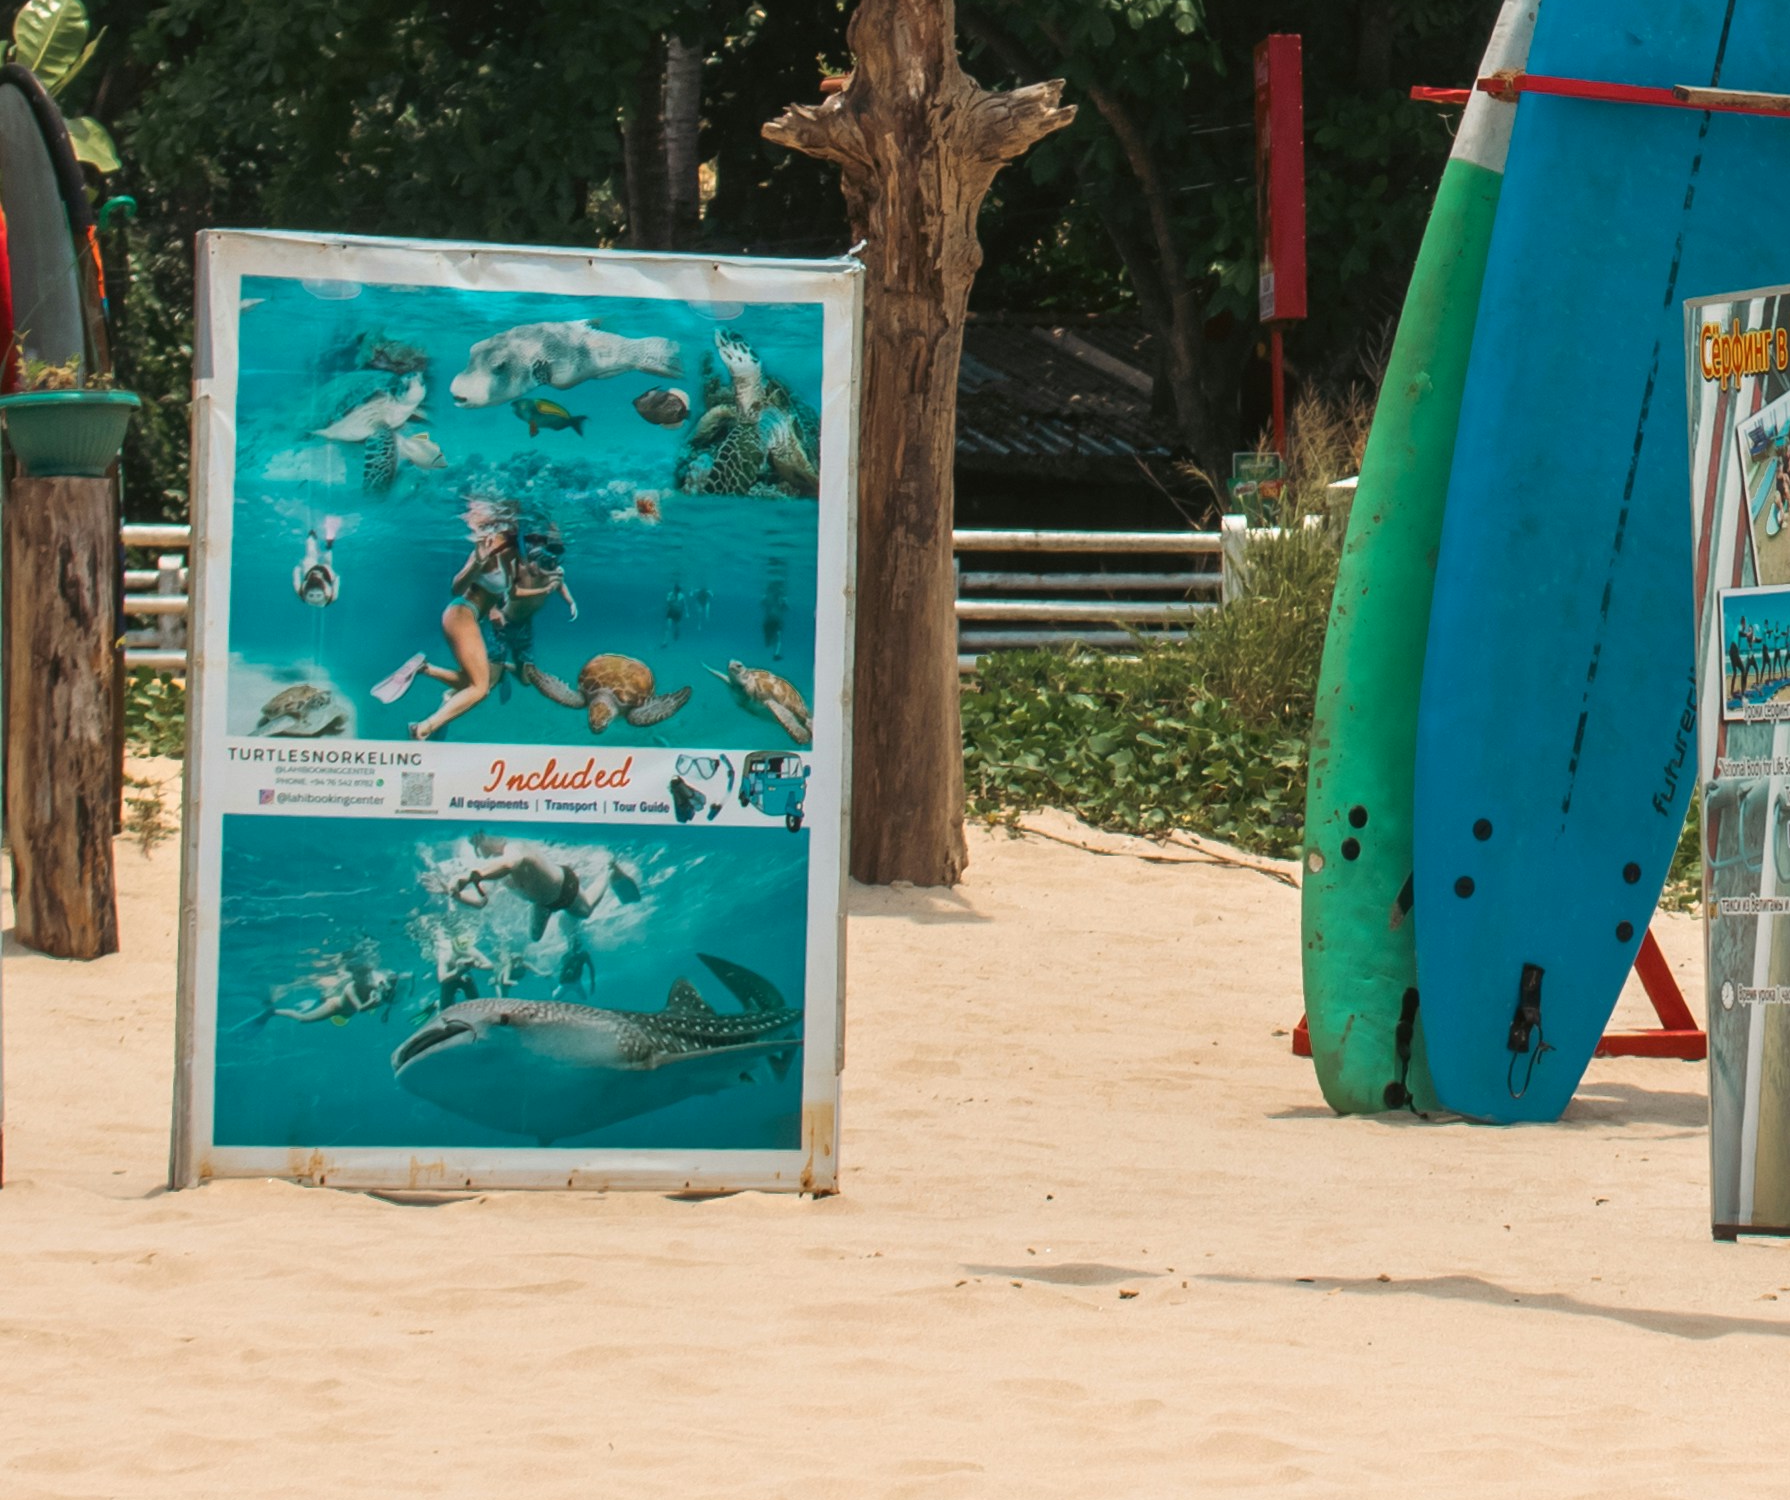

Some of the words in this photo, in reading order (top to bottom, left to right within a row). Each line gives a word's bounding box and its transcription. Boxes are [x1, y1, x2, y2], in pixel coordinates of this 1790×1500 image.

[1700, 317, 1772, 391] Сёрфинг
[1776, 327, 1788, 371] в
[227, 746, 423, 766] TURTLESNORKELING
[1773, 757, 1784, 775] Life
[482, 755, 633, 793] Included
[277, 792, 385, 807] @lahibookingcenter
[449, 796, 464, 809] All
[466, 797, 529, 812] equipments
[545, 798, 598, 812] Transport
[613, 800, 637, 812] Tour
[639, 800, 671, 814] Guide
[1738, 984, 1758, 1005] Время
[1758, 988, 1776, 1004] урока
